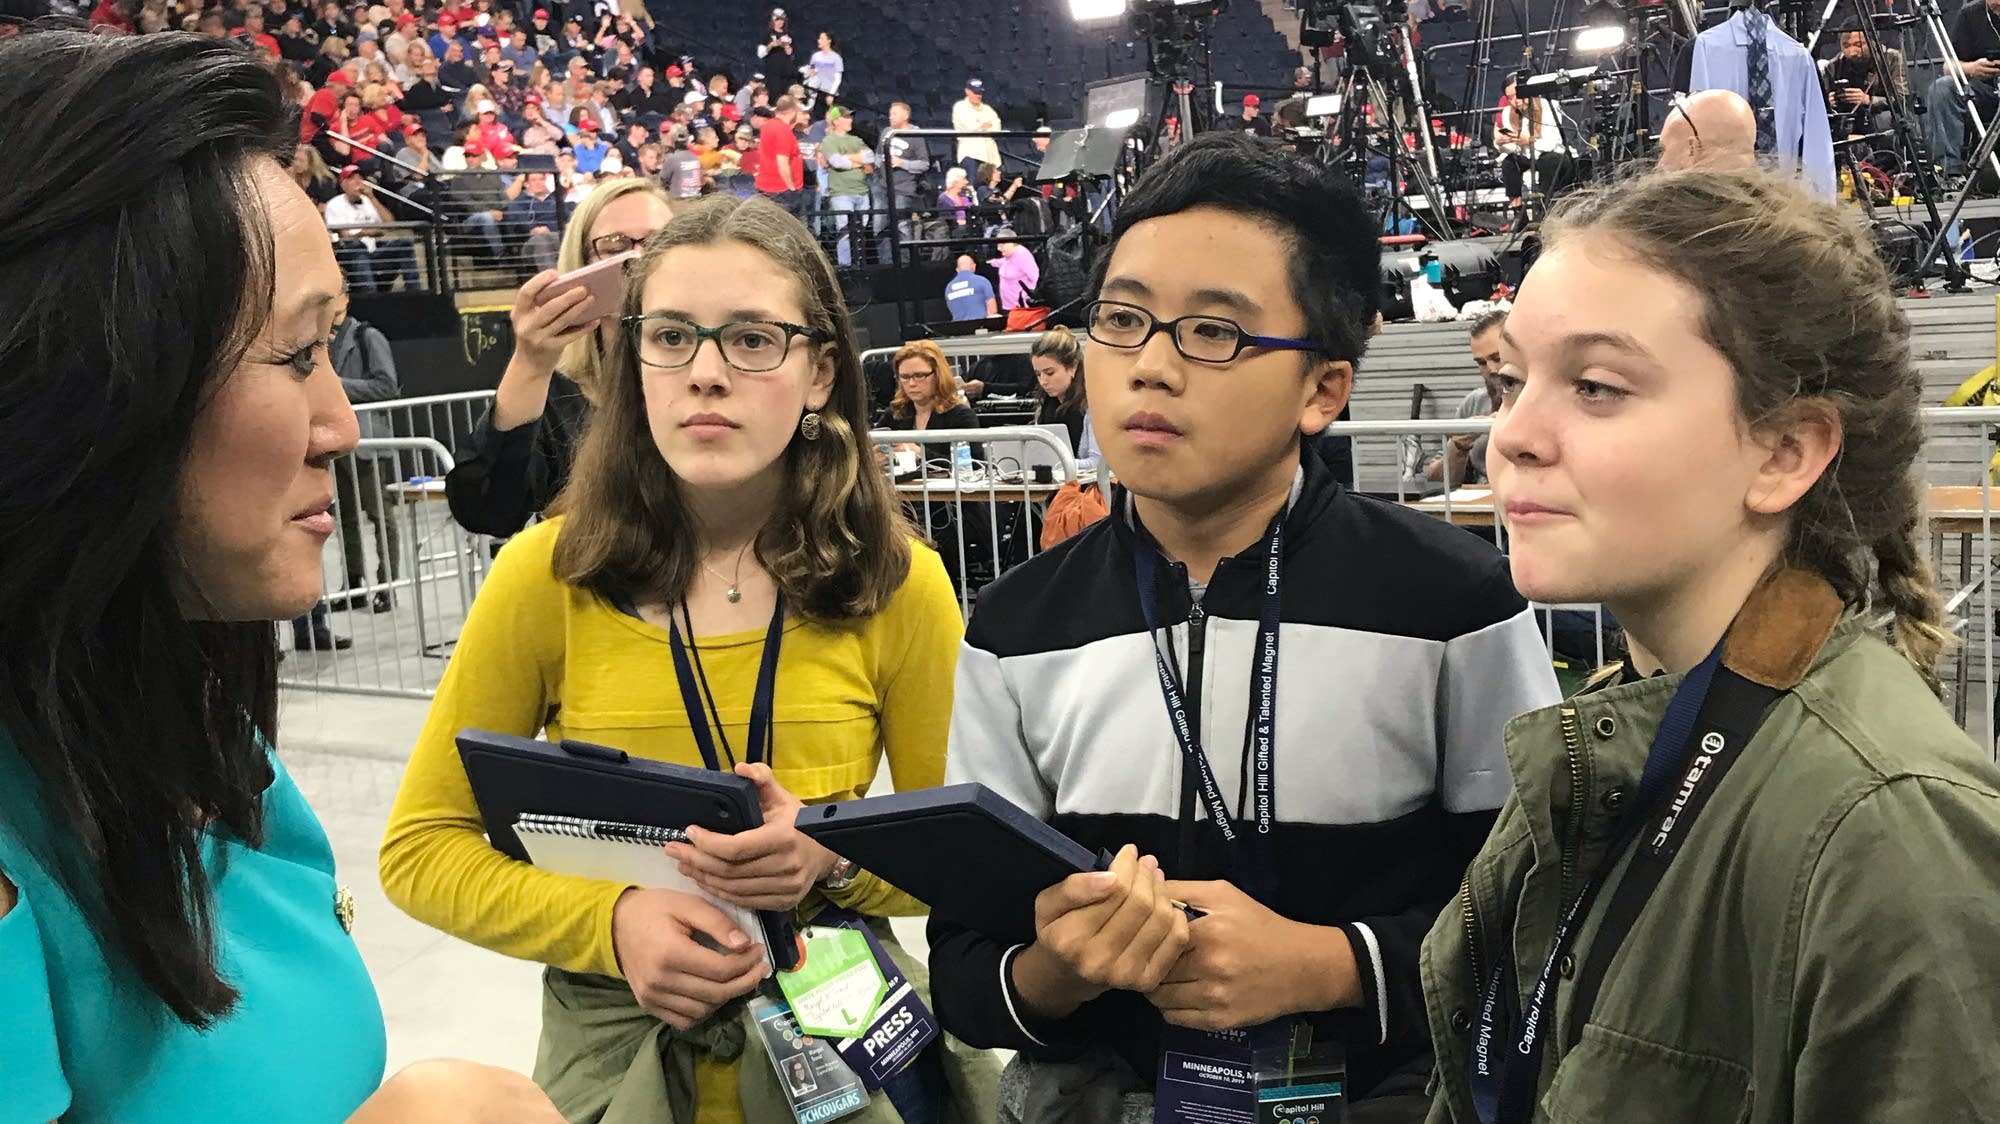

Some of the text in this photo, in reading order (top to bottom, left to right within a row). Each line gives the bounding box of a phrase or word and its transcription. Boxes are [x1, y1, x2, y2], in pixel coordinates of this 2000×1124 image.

[1266, 556, 1281, 595] Capitol
[1168, 689, 1178, 710] Hill
[1257, 631, 1277, 834] Capitol Hill Gifted & Talented Magnet
[1211, 799, 1236, 841] Magnet
[1652, 755, 1712, 848] tamrac
[863, 1006, 913, 1058] PRESS
[1518, 980, 1547, 1055] Capitol Hill
[880, 1033, 912, 1066] MINNEAPOLIS,
[1475, 1023, 1493, 1076] Magnet
[1183, 1061, 1245, 1079] MINNEAPOLIS,
[1199, 1072, 1222, 1081] OCTOBER
[800, 1092, 860, 1124] #CHCOUGARS
[1311, 1103, 1325, 1111] Hill
